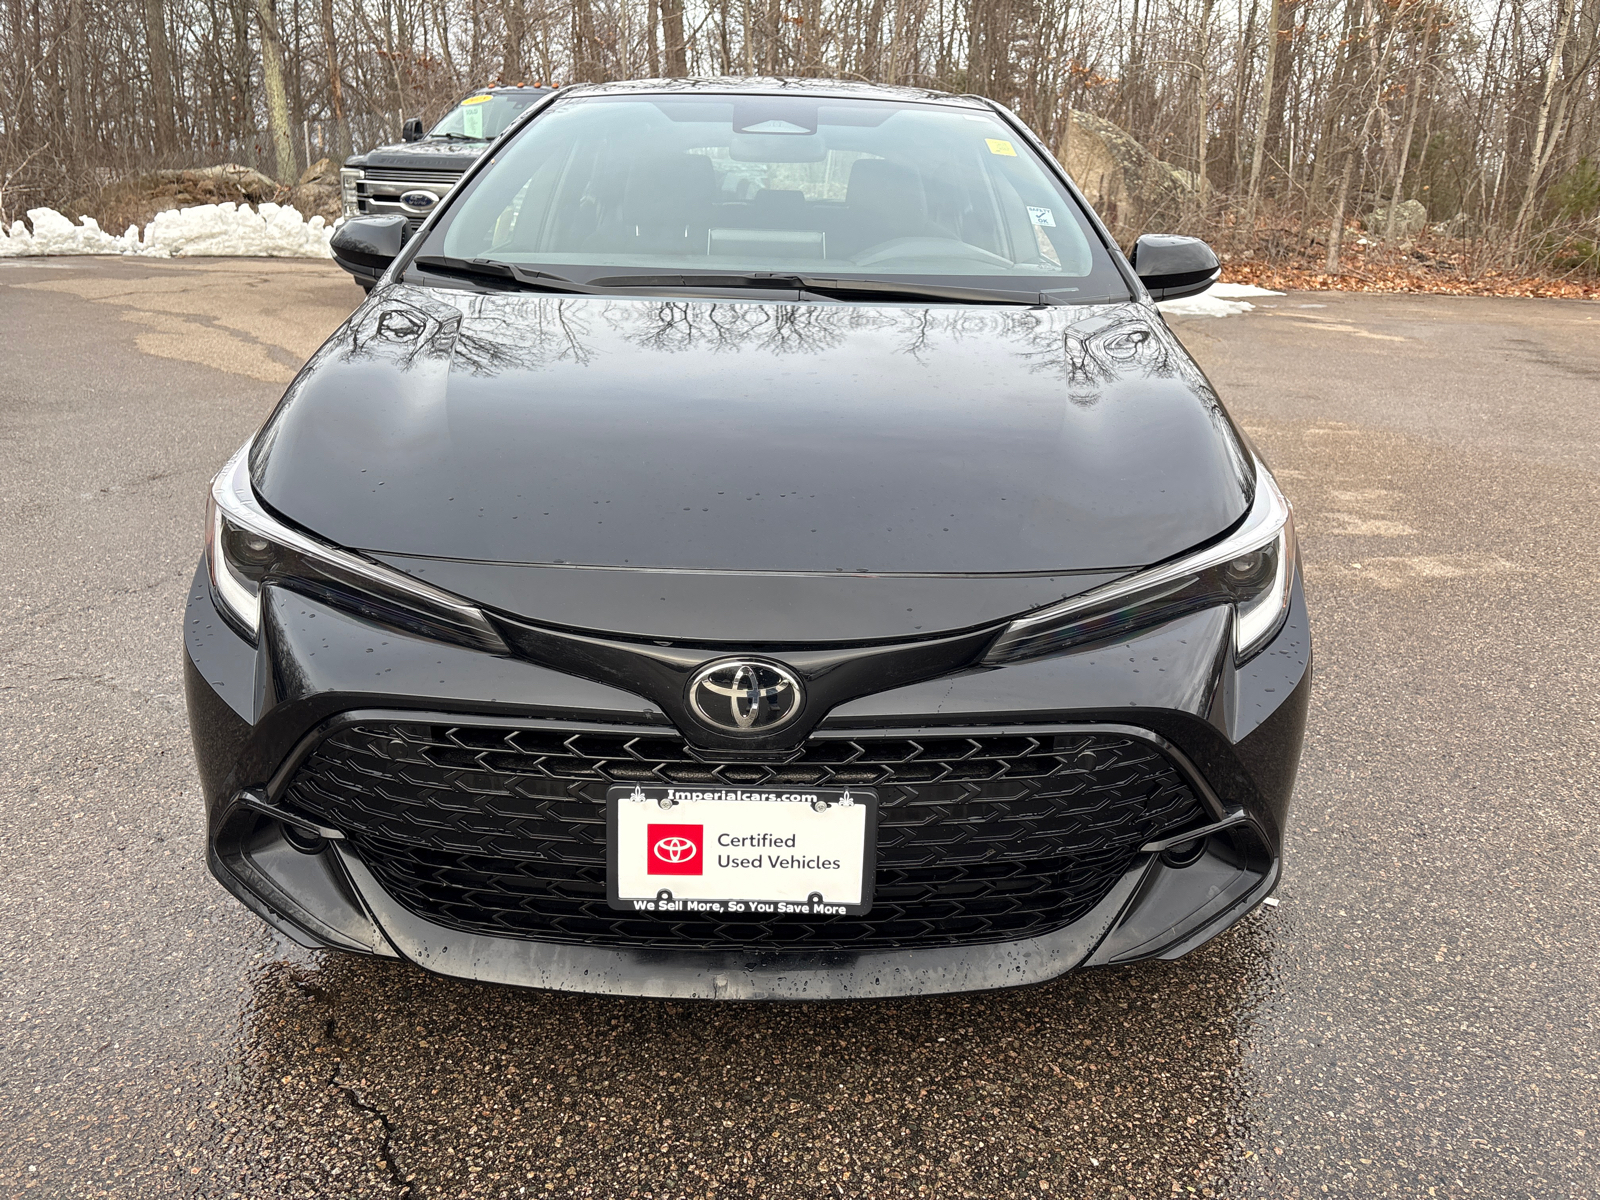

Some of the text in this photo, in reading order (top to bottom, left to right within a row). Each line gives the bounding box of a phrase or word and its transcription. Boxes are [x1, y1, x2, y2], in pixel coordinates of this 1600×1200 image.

[667, 789, 818, 803] Imperialcars.com
[717, 833, 796, 848] Certified
[717, 854, 841, 870] Used Vehicles
[633, 900, 847, 915] We Sell More, So You Save More
